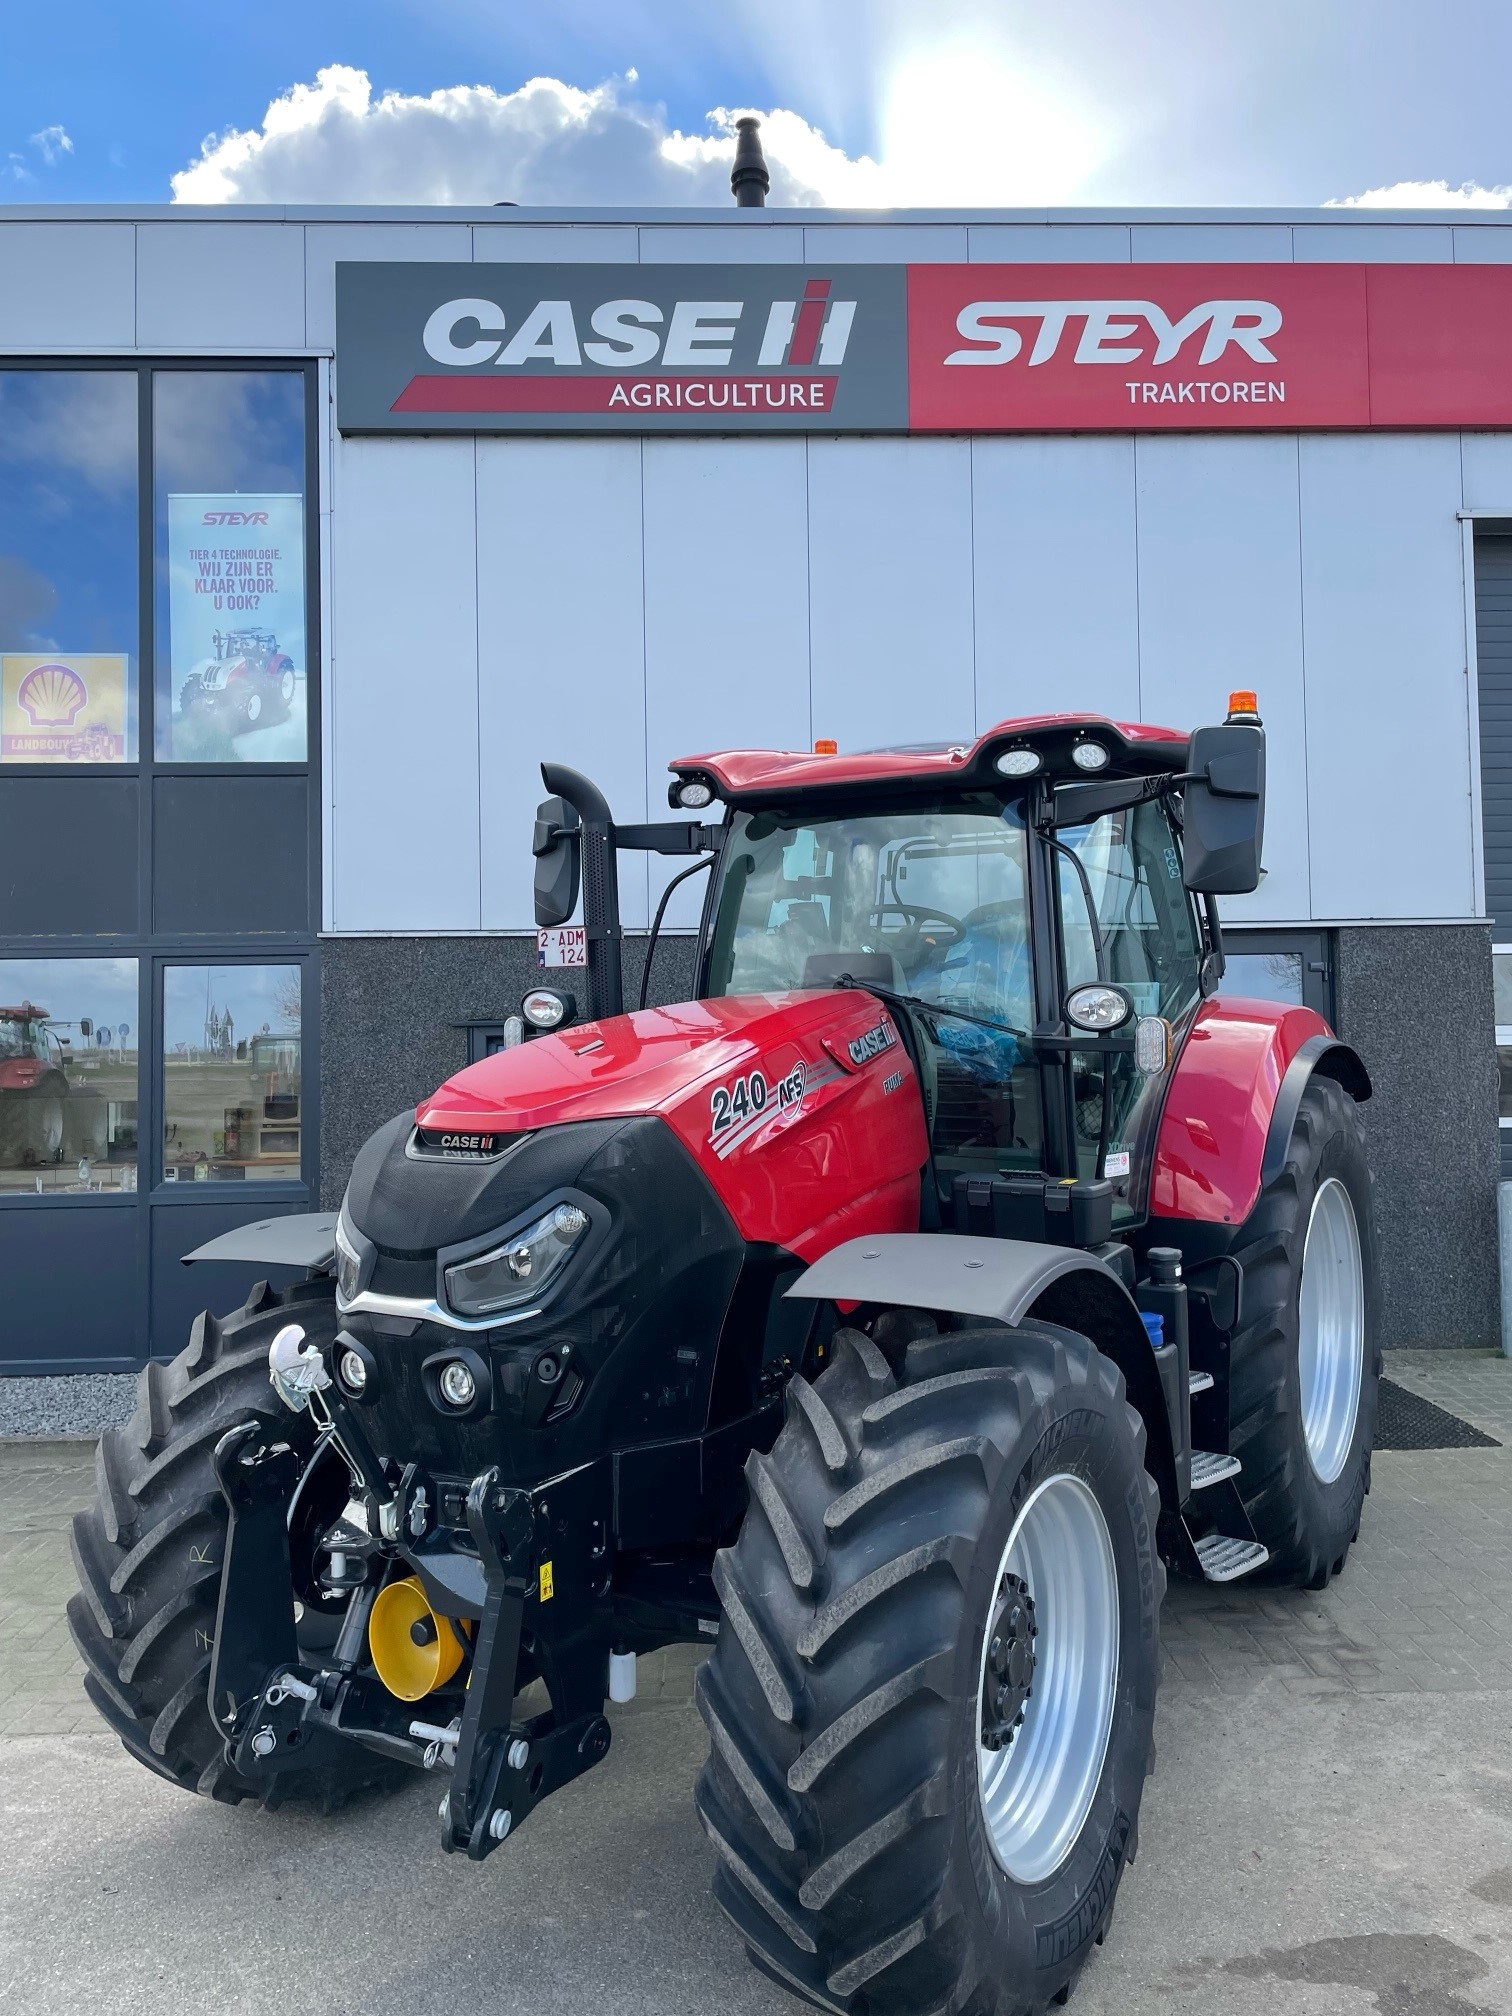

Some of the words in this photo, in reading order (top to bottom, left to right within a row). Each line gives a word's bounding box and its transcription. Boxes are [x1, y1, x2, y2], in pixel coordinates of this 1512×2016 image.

[422, 297, 745, 368] CASE
[943, 299, 1284, 367] STEYR
[608, 382, 826, 408] AGRICULTURE
[1125, 380, 1286, 404] TRAKTOREN
[201, 511, 270, 526] STEYR
[189, 549, 209, 560] TIER
[211, 549, 217, 560] 4
[219, 548, 283, 560] TECHNOLOGIE.
[199, 561, 221, 577] WIJ
[225, 561, 253, 577] ZIJN
[256, 561, 274, 577] ER
[194, 578, 236, 594] KLAAR
[239, 578, 279, 594] VOOR.
[213, 595, 223, 611] U
[227, 594, 260, 611] OOK?
[560, 948, 584, 964] 124
[848, 1027, 887, 1064] CASE
[777, 1069, 805, 1112] AFS
[711, 1070, 767, 1134] 240
[441, 1135, 480, 1149] CASE
